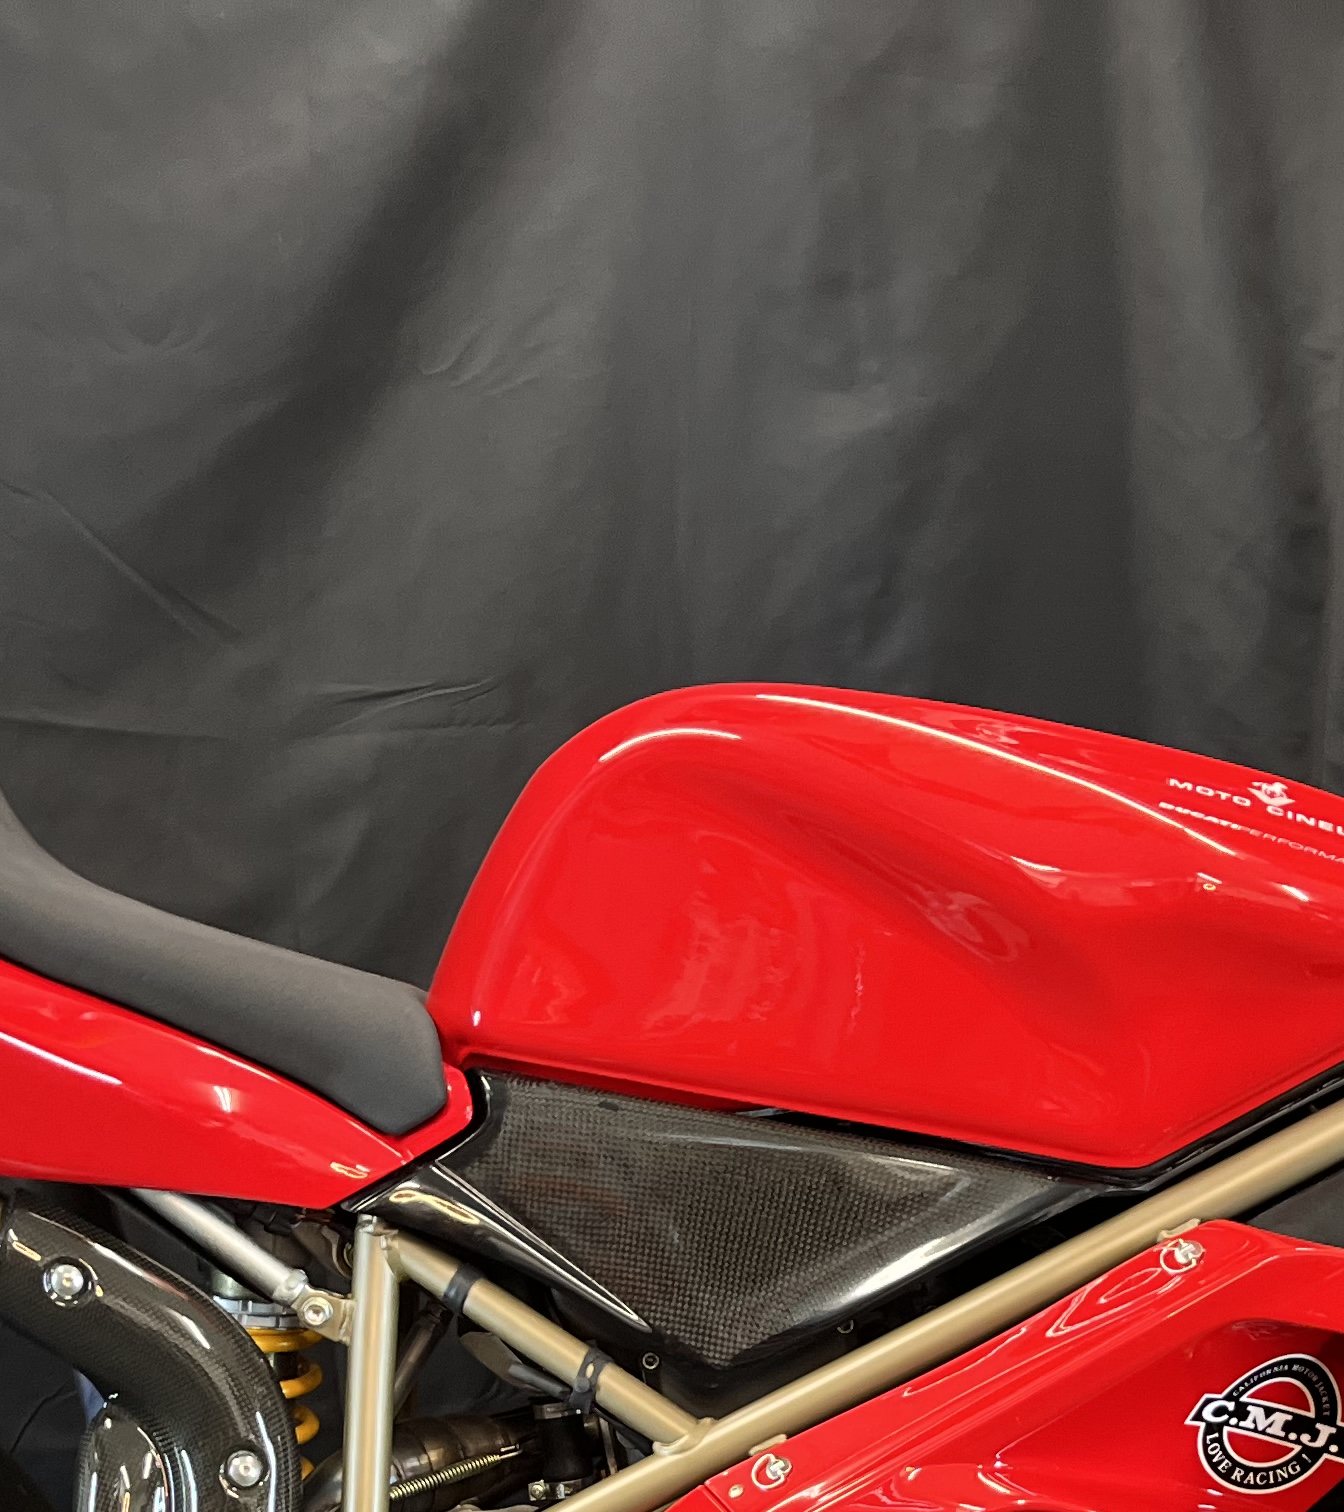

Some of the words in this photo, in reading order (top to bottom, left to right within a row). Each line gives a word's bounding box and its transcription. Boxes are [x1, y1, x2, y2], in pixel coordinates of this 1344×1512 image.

[1167, 778, 1251, 807] MOTO
[1232, 1364, 1289, 1397] CALIFORNIA
[1202, 1400, 1339, 1453] C.M.J.
[1206, 1432, 1233, 1474] LOVE
[1231, 1460, 1302, 1486] RACING
